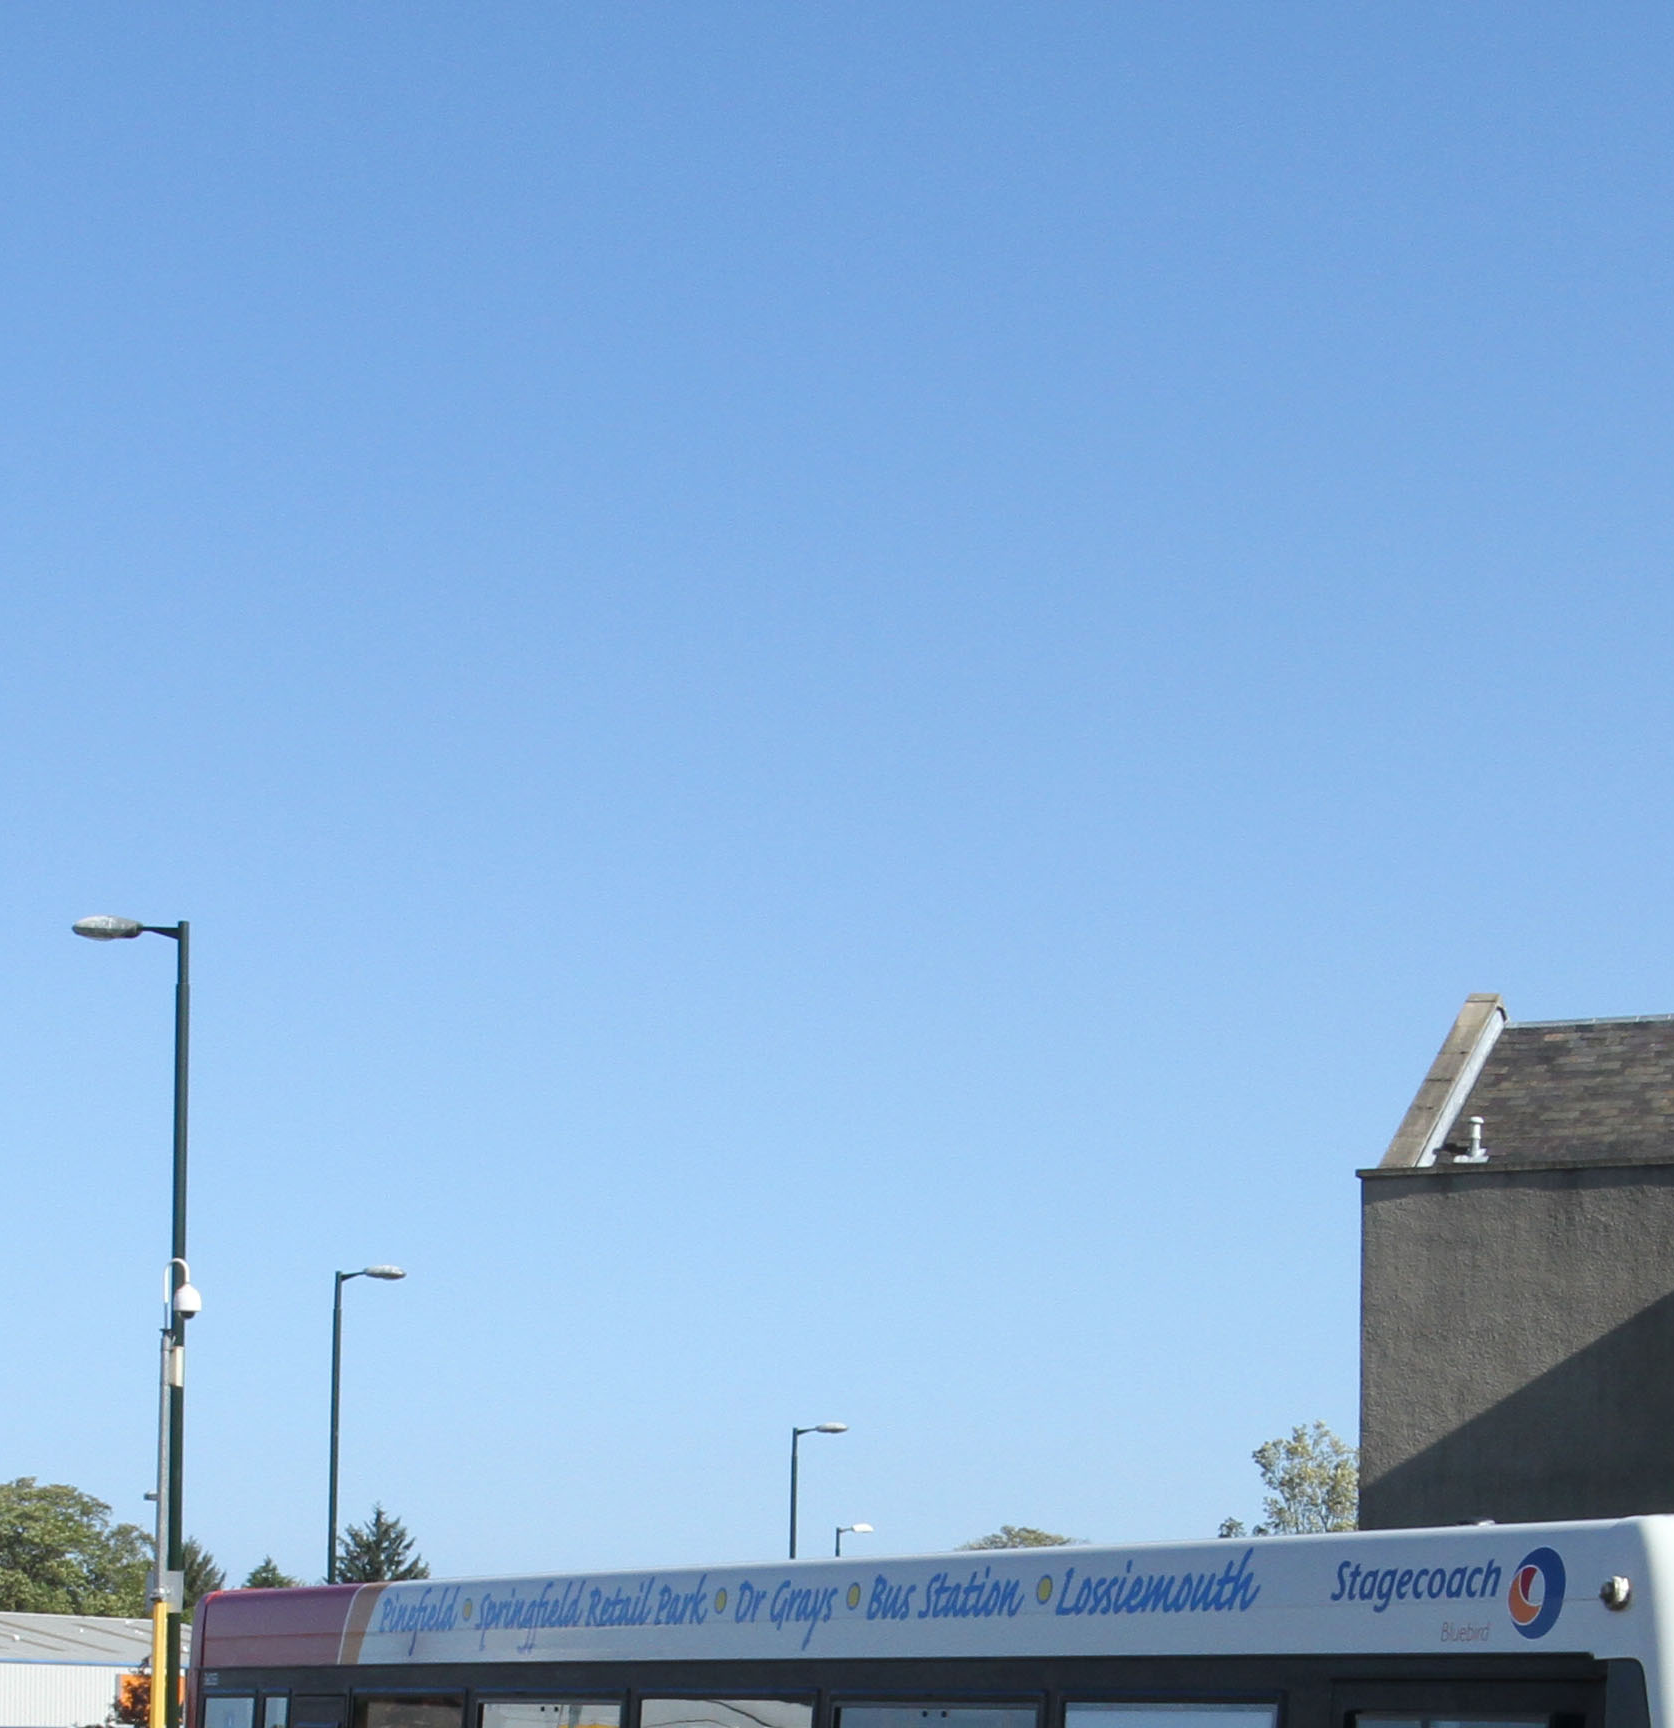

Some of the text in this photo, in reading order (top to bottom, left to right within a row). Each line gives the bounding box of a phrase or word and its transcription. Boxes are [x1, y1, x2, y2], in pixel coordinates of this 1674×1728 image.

[476, 1580, 586, 1653] Springfield
[585, 1576, 655, 1627] Retail
[654, 1573, 708, 1625] Park
[734, 1580, 767, 1623] Dr
[770, 1579, 838, 1650] Grays
[866, 1574, 917, 1620] Bus
[918, 1566, 1025, 1619] Station
[1055, 1547, 1261, 1616] Lossiemouth
[1331, 1558, 1502, 1613] Stagecoach
[1439, 1620, 1490, 1642] Bluebird
